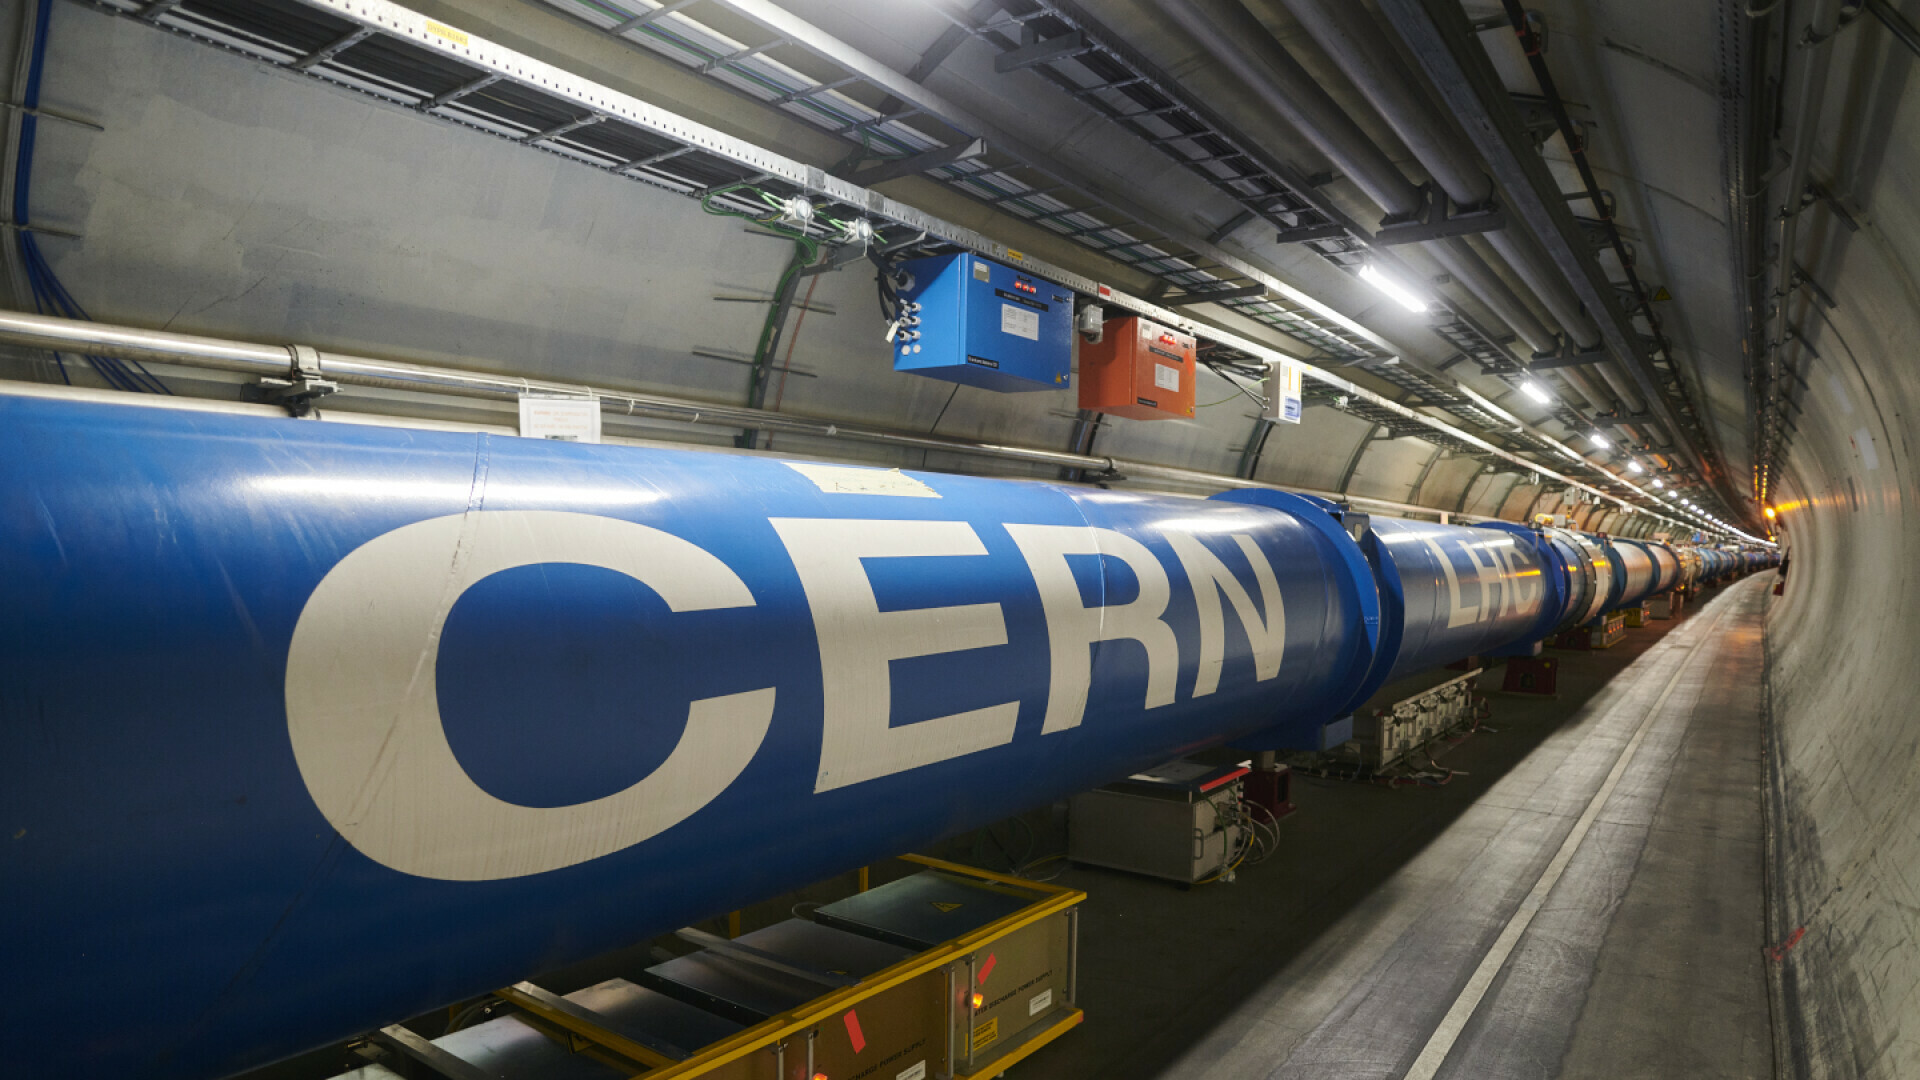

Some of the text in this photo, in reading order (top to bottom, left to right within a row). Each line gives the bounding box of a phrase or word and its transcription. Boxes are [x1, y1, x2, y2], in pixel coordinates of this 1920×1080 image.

[1423, 536, 1537, 629] LHC
[285, 511, 1286, 881] CERN
[988, 989, 1017, 1009] DISCHARGE
[1018, 979, 1035, 991] POWER
[1035, 969, 1053, 983] SUPPLY
[879, 1051, 903, 1068] POWER
